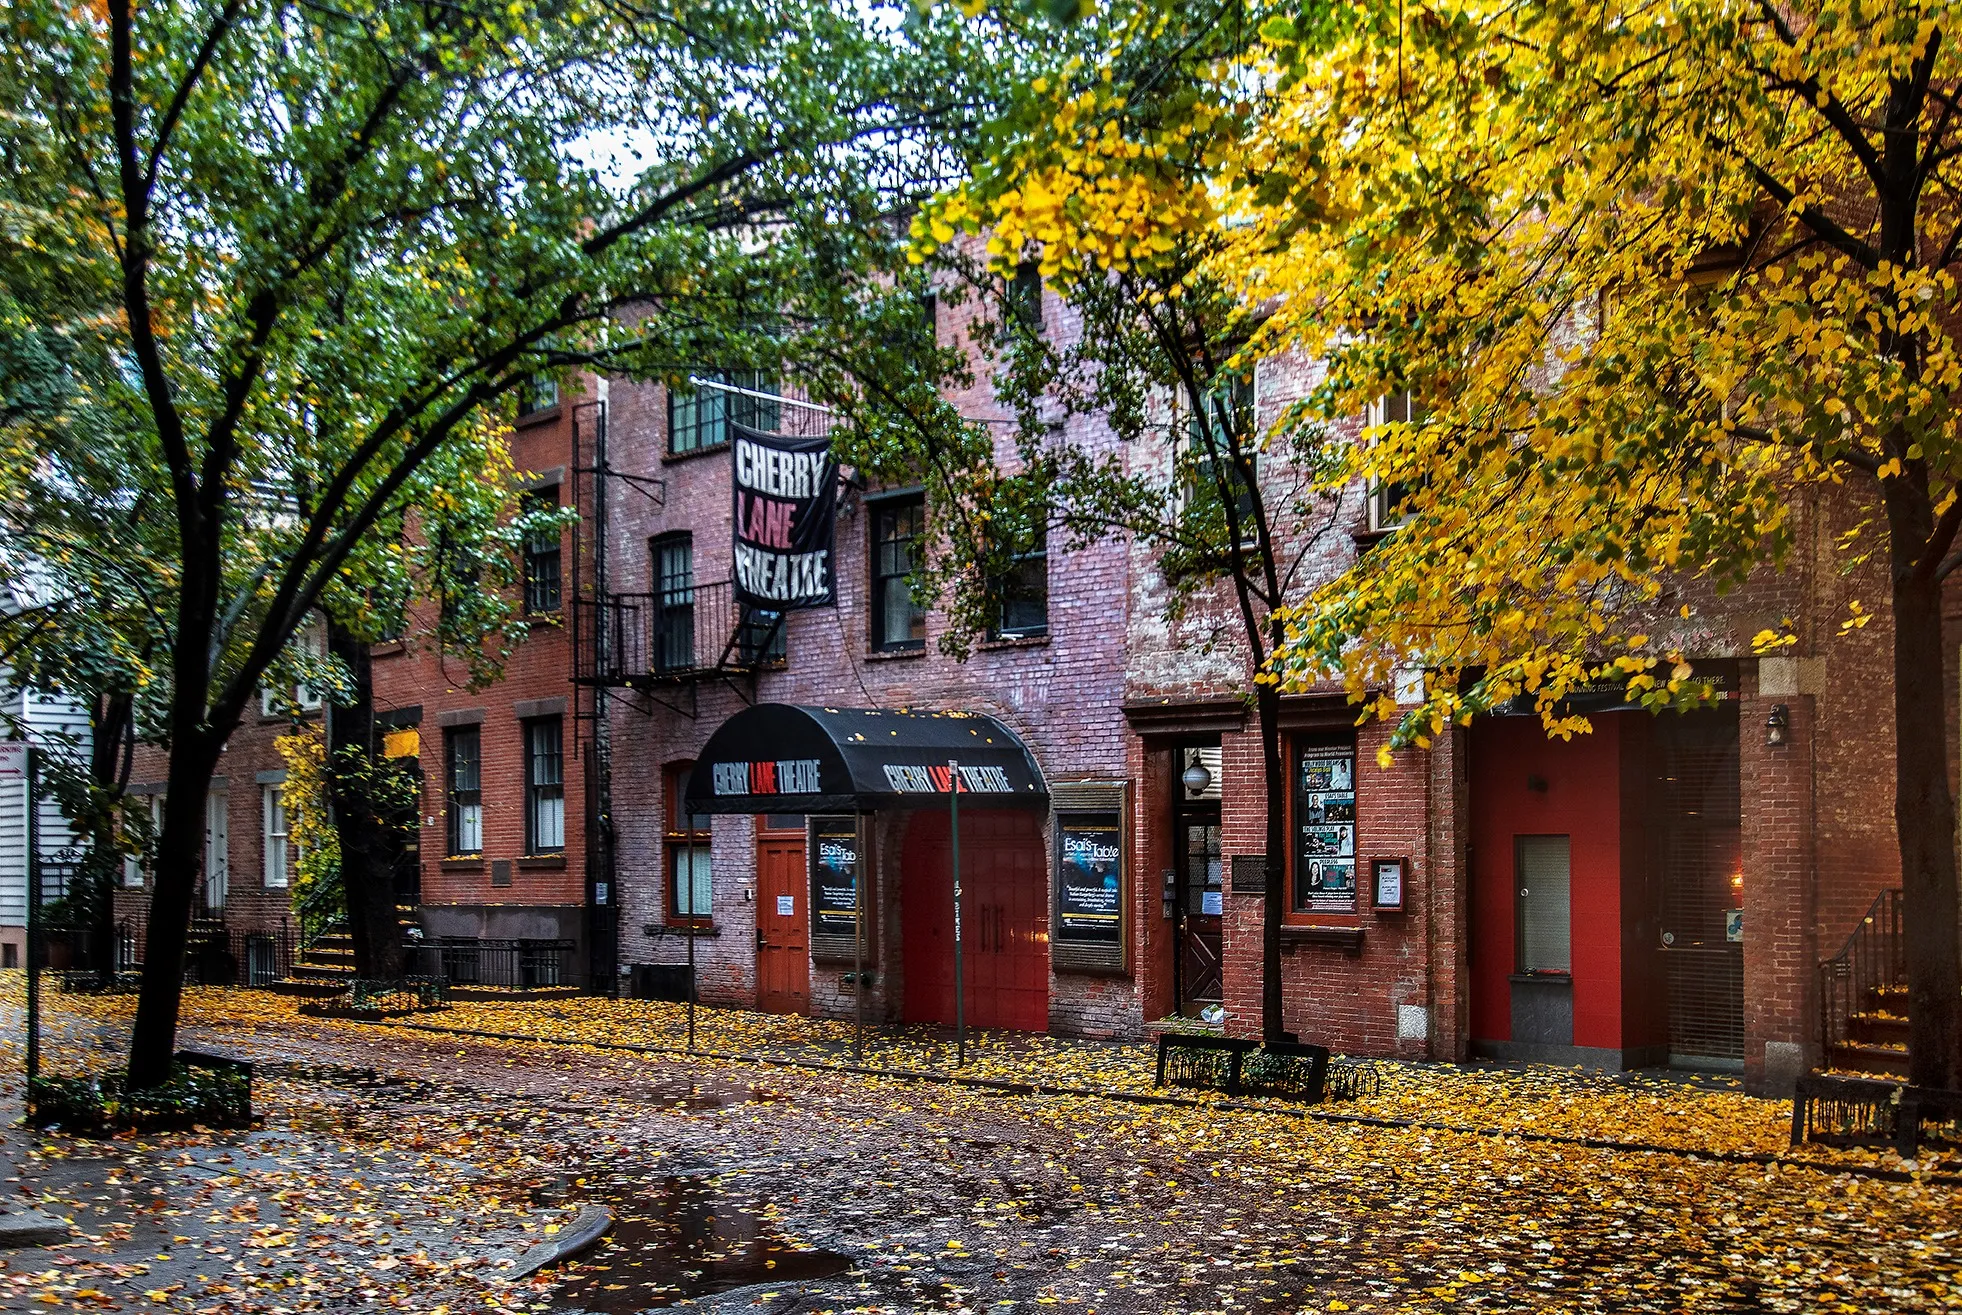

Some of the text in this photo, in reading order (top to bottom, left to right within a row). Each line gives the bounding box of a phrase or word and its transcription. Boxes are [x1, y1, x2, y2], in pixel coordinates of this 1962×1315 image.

[736, 438, 828, 498] CHERRY
[737, 490, 797, 549] LANE
[713, 759, 822, 795] CHERRY LANE THEATRE
[882, 764, 936, 793] CHERRY
[957, 765, 1014, 793] THEATRE
[841, 848, 857, 861] Tab
[1091, 843, 1119, 857] Table
